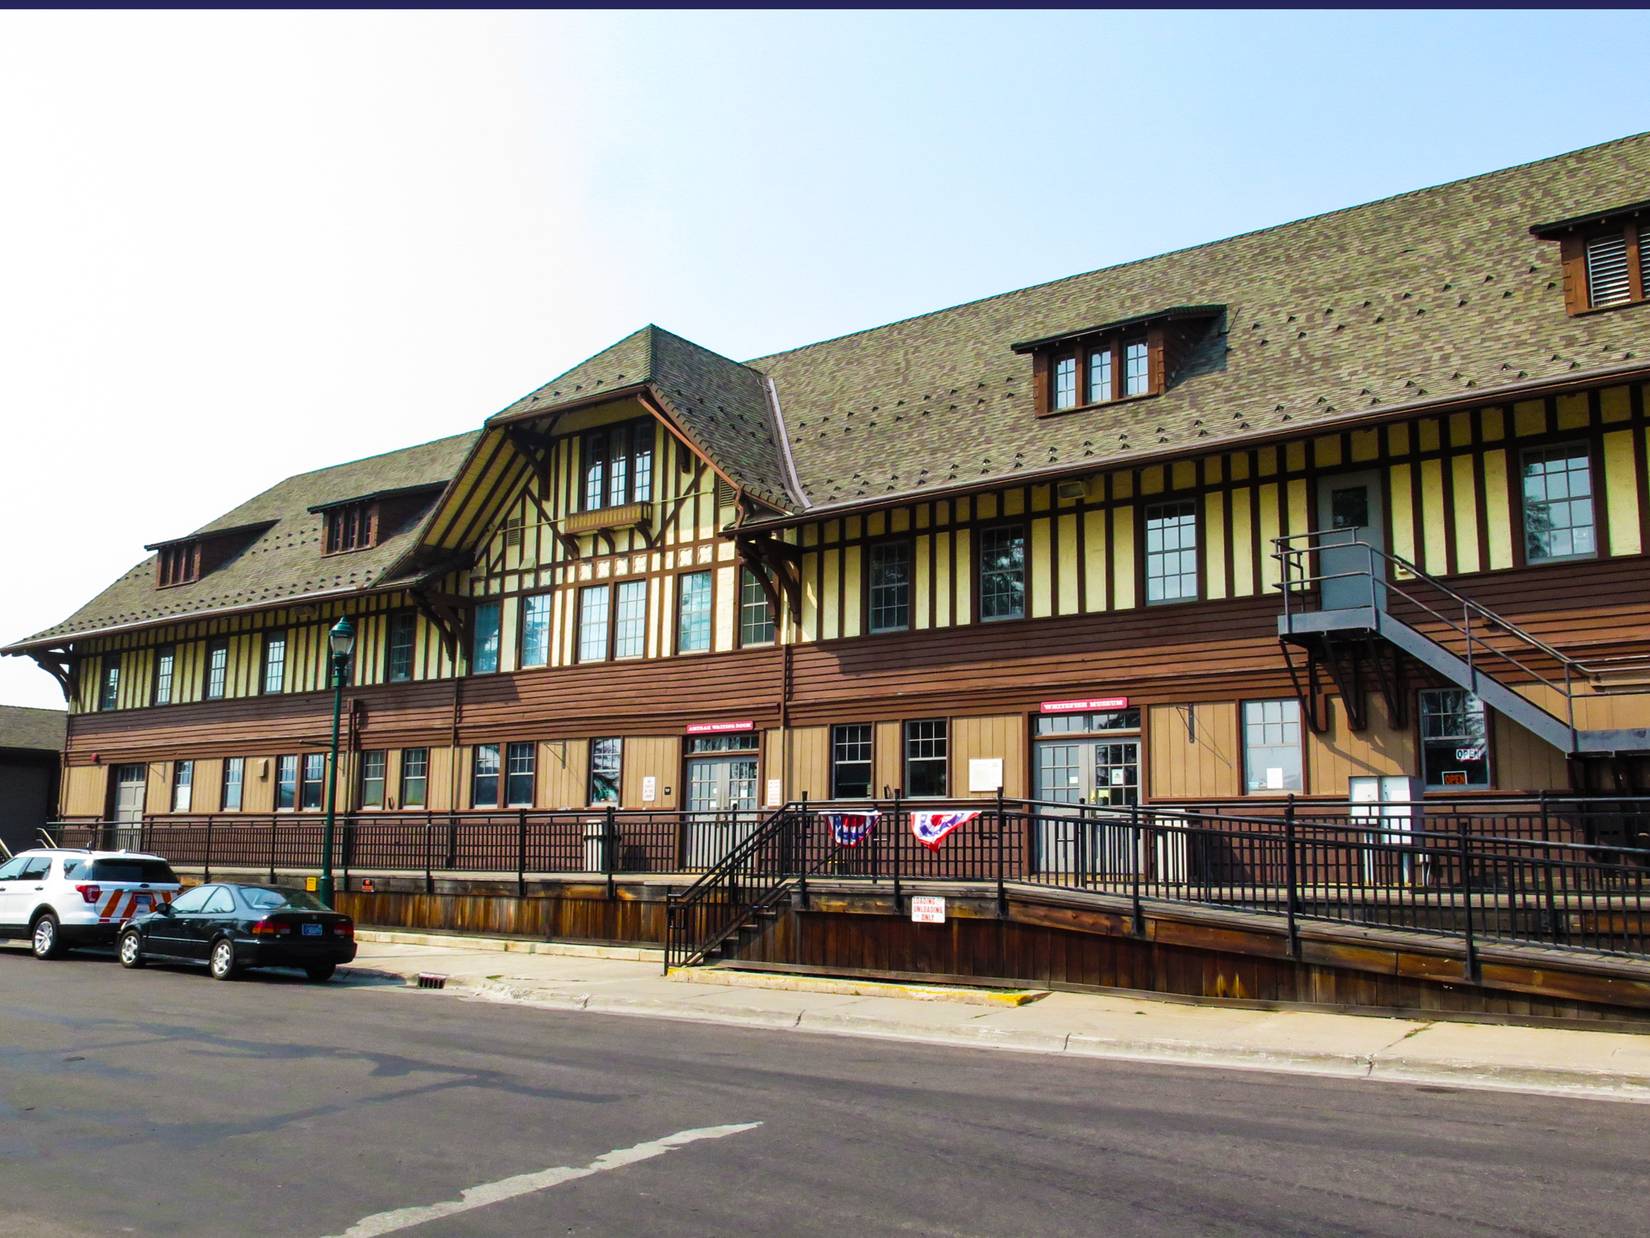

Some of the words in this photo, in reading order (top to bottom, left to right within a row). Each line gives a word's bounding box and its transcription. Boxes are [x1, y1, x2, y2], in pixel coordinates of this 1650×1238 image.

[1090, 699, 1124, 707] MUSEUM
[1457, 749, 1481, 760] OPEN
[1445, 774, 1465, 784] OPEN
[913, 905, 943, 913] UNLOADING
